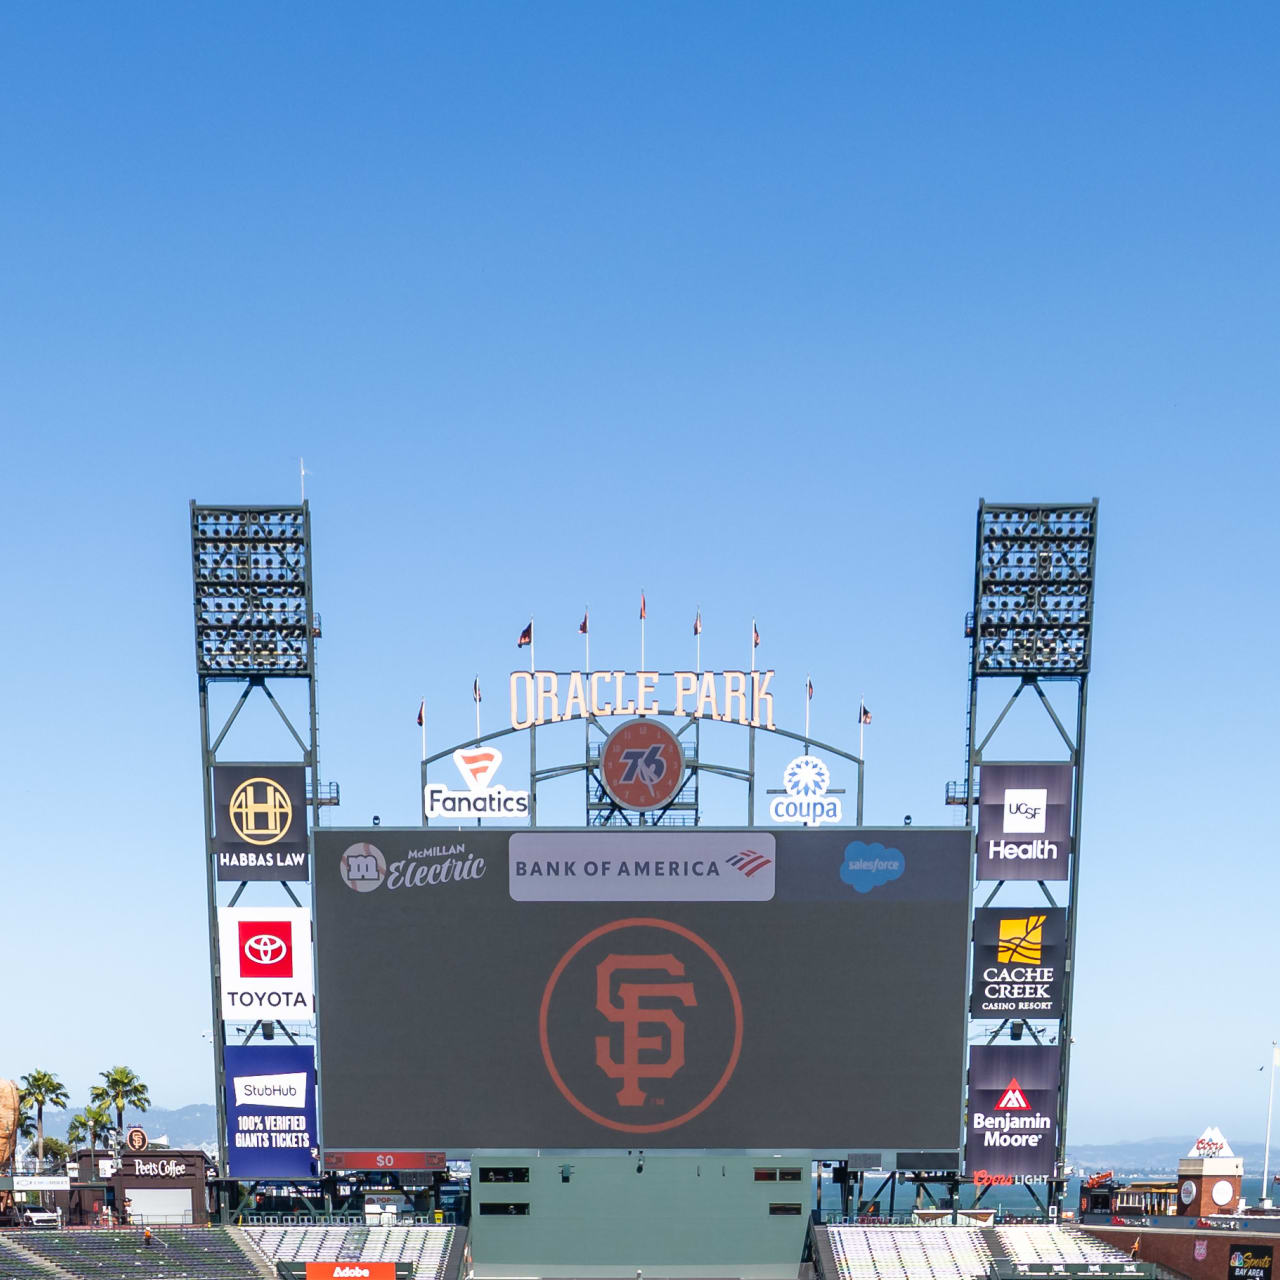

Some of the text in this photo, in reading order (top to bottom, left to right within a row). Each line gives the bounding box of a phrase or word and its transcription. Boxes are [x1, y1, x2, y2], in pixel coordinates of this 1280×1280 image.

[510, 669, 777, 730] ORACLE PARK
[619, 744, 667, 784] 76
[429, 788, 528, 812] Fanatics
[774, 799, 838, 823] coupa
[1009, 803, 1041, 819] UCSF
[408, 843, 466, 860] McMILLAN
[988, 839, 1058, 860] Health
[220, 853, 305, 867] HABBAS LAW
[848, 859, 899, 873] salesforce
[387, 854, 486, 891] Electric
[515, 861, 721, 877] BANK OF AMERICA
[983, 967, 1054, 982] CACHE
[227, 991, 307, 1008] TOYOTA
[984, 983, 1051, 999] CREEK
[982, 1001, 1053, 1010] CASINO RESORT
[595, 953, 699, 1107] SF
[243, 1085, 297, 1097] StubHub
[237, 1115, 306, 1131] 100% VERIFIED
[973, 1112, 1051, 1132] Benjamin
[235, 1131, 309, 1148] GIANTS TICKETS
[983, 1131, 1039, 1147] Moore
[158, 1159, 186, 1178] Coffee
[973, 1169, 1049, 1187] Coors LIGHT
[1242, 1251, 1272, 1268] Sports
[333, 1267, 370, 1278] Adobe
[1234, 1268, 1264, 1277] BAY AREA
